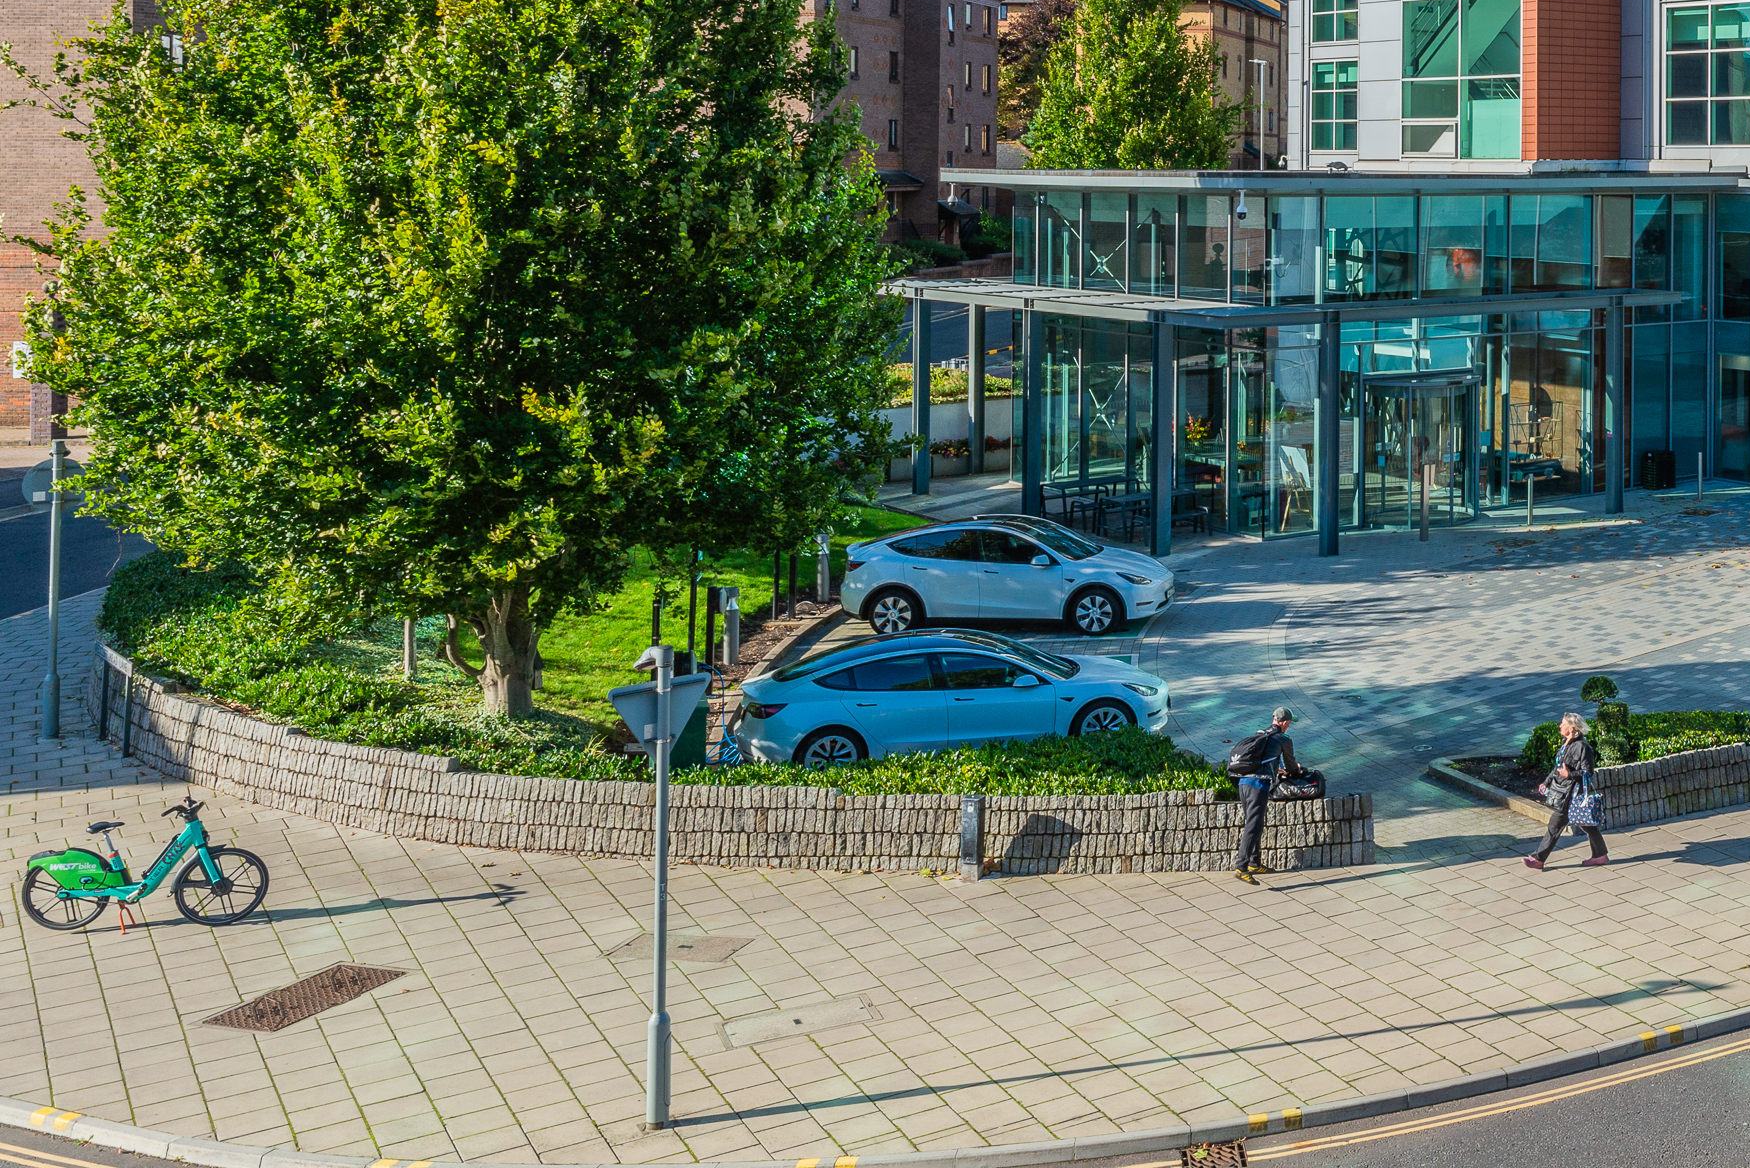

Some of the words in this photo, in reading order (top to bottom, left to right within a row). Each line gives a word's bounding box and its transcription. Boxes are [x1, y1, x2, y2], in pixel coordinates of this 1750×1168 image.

[149, 865, 164, 881] TIER
[660, 883, 666, 892] T
[660, 893, 666, 901] 3
